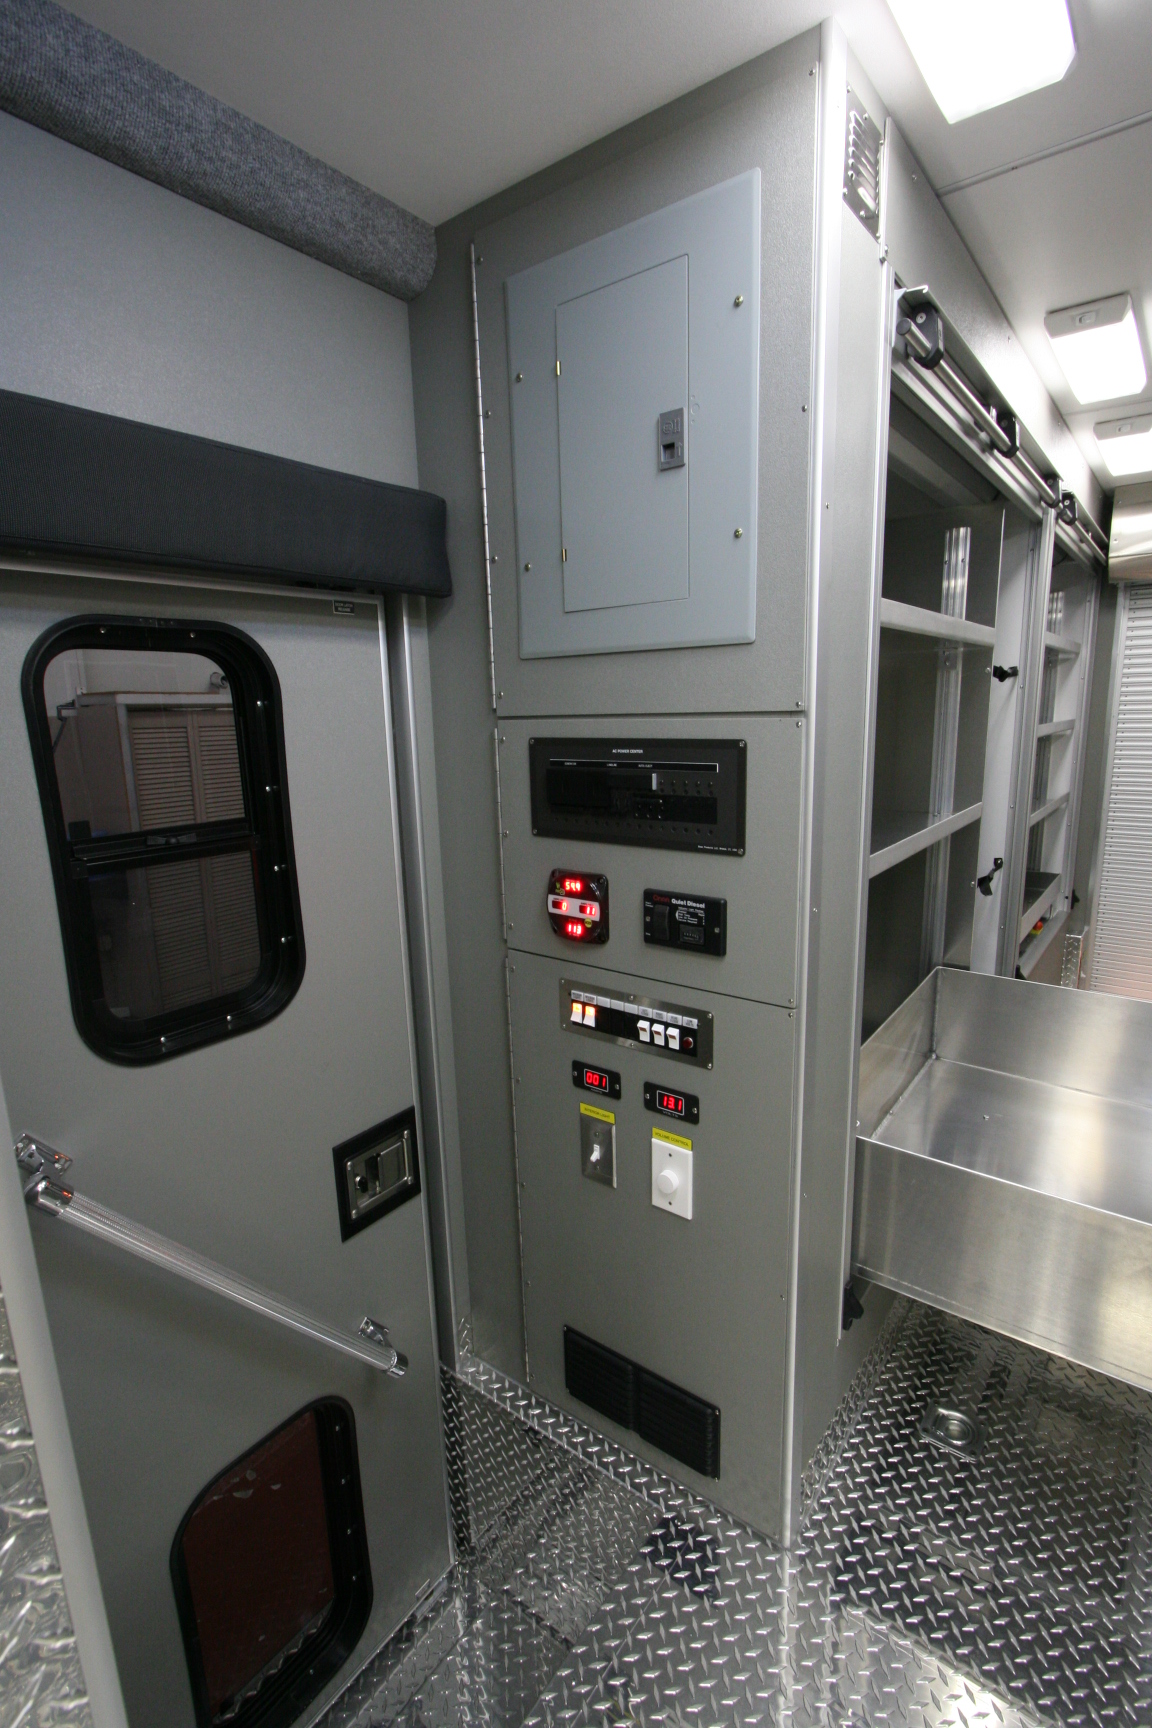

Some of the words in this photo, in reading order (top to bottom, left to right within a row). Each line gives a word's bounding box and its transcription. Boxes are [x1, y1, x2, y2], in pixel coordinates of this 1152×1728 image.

[671, 898, 687, 906] Quiet
[687, 901, 705, 909] Diesel
[655, 1132, 670, 1140] VOLUME
[671, 1136, 689, 1146] CONTROL
